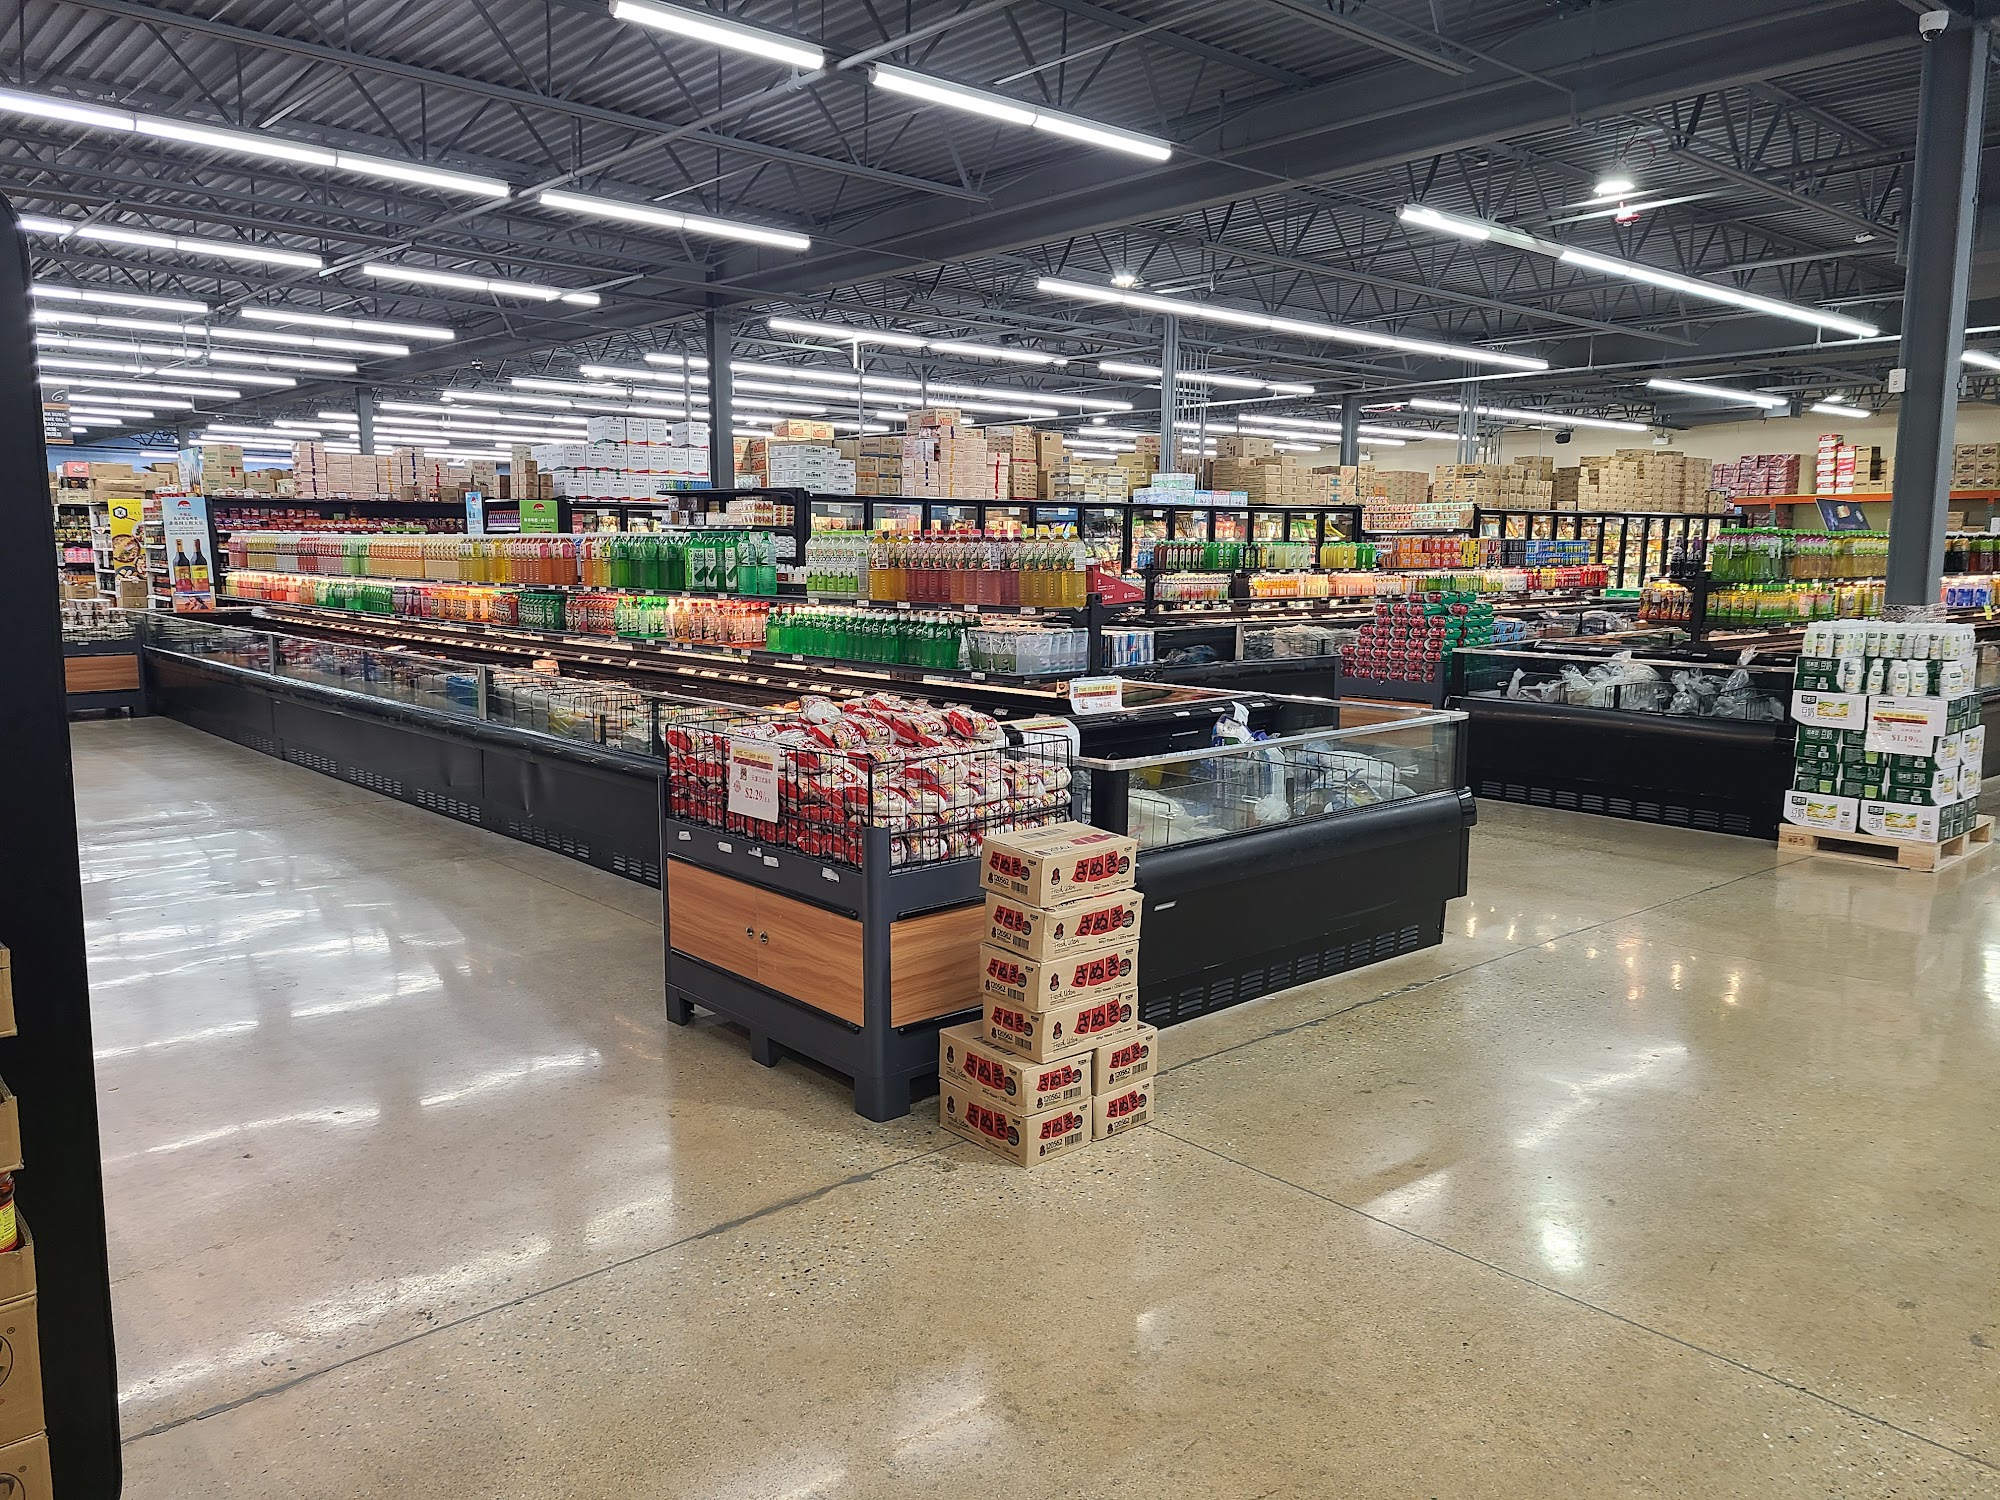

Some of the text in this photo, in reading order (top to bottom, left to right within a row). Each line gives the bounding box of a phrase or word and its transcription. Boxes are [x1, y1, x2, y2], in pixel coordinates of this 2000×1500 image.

[51, 390, 66, 402] 6
[744, 788, 770, 804] $2.29/EA
[990, 852, 1021, 875] さぬき
[1075, 854, 1118, 881] さぬき
[995, 906, 1023, 930] さぬき
[1078, 907, 1122, 934] さぬき
[988, 960, 1018, 982] さぬき
[1074, 956, 1118, 984] さぬき
[993, 1008, 1024, 1032] さぬき
[1077, 1002, 1119, 1032] さぬき
[1110, 1044, 1140, 1067] さぬき
[965, 1054, 1004, 1088] さぬき
[1039, 1067, 1072, 1090] さぬき
[1109, 1094, 1138, 1117] さぬき
[967, 1104, 1006, 1138] さぬき
[1041, 1114, 1074, 1138] さぬき
